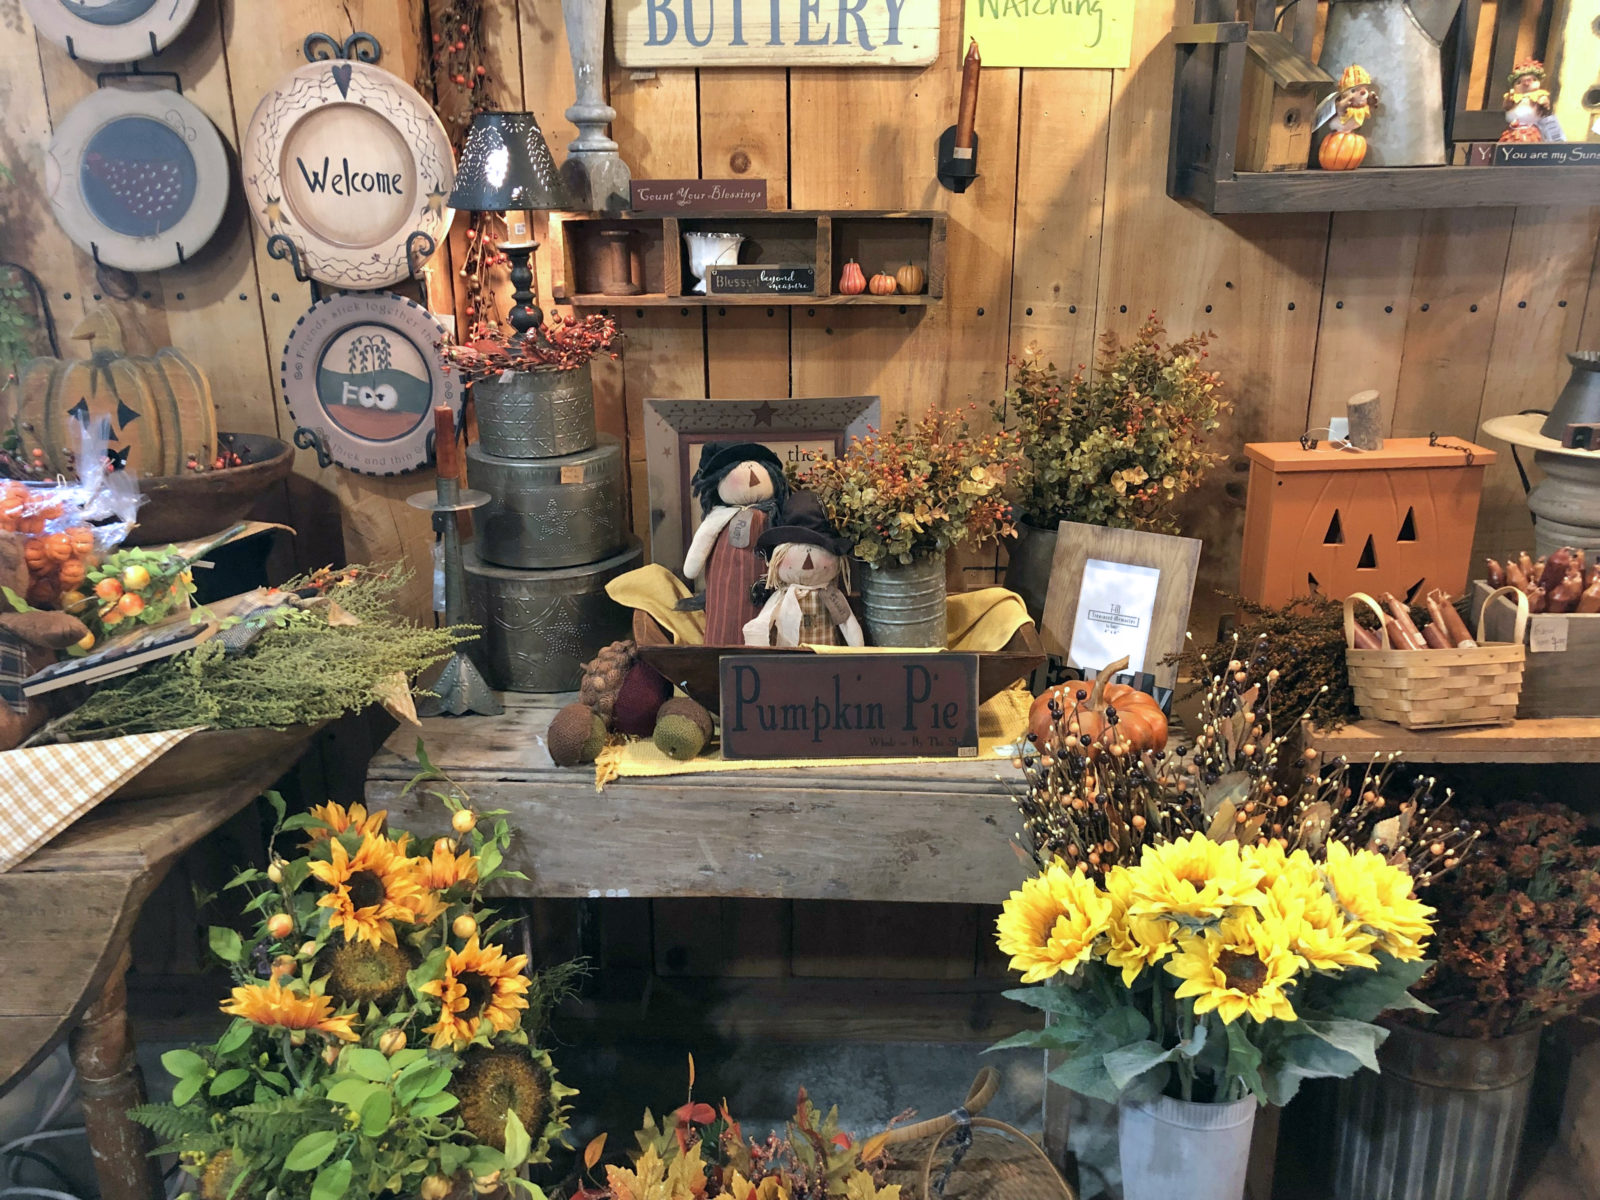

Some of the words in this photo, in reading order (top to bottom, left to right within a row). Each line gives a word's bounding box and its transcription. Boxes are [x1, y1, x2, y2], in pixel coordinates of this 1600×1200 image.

[643, 0, 904, 51] BUTTERY
[1502, 146, 1527, 161] You
[1529, 151, 1548, 160] are
[1550, 151, 1567, 164] my
[296, 156, 404, 197] Welcome
[636, 187, 674, 202] Count
[676, 186, 706, 206] Your
[708, 184, 762, 203] Blessings
[760, 270, 796, 284] beyond
[364, 456, 387, 466] and
[390, 453, 413, 465] thin
[731, 664, 886, 743] Pumpkin
[902, 664, 959, 732] Pie
